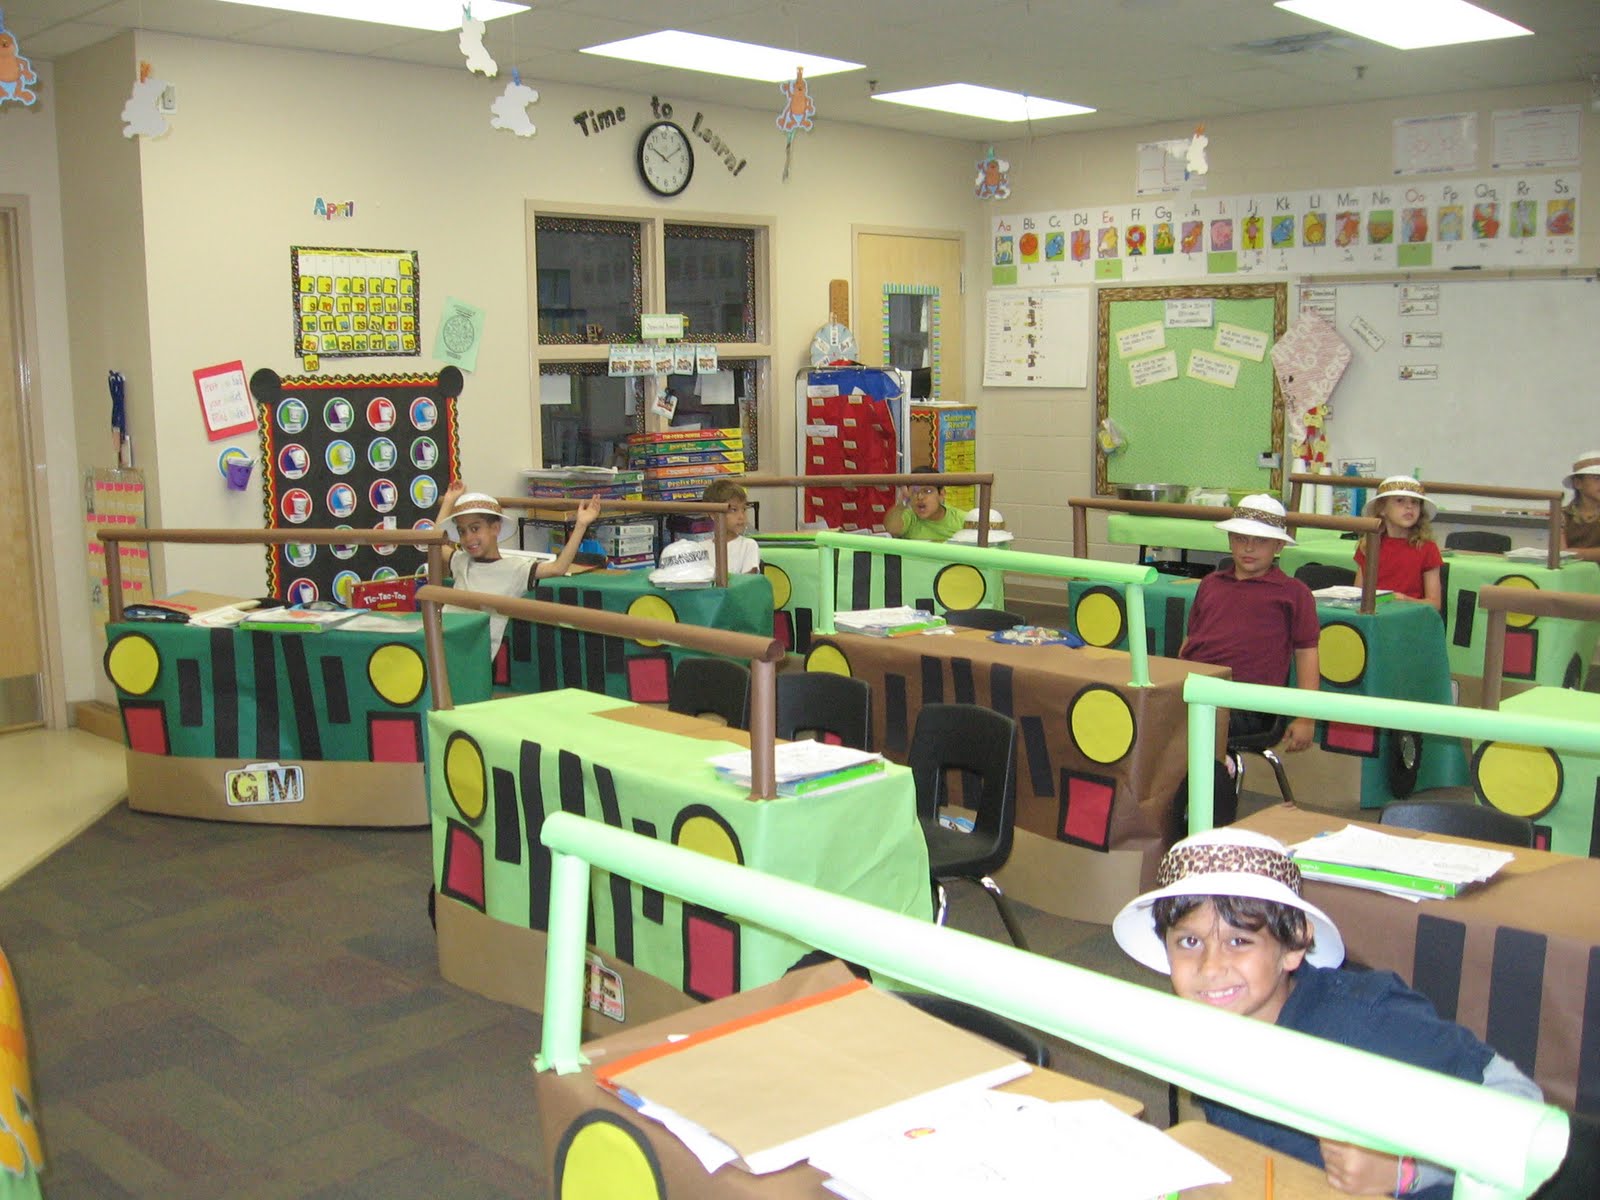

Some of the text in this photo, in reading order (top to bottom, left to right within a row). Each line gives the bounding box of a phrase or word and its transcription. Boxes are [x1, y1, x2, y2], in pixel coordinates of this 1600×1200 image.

[573, 95, 747, 176] Time to Learn!
[313, 197, 354, 220] April
[998, 220, 1011, 231] Aa
[1023, 218, 1035, 230] Bb
[1049, 216, 1061, 227] Cc
[1074, 213, 1088, 226] Dd
[1103, 211, 1114, 223] Ee
[1131, 208, 1141, 221] Ff
[1155, 206, 1172, 221] Gg
[1248, 200, 1258, 217] Jj
[1276, 197, 1290, 211] Kk
[1337, 192, 1358, 208] Mm
[1372, 191, 1391, 205] Nn
[1405, 189, 1424, 202] Oo
[1475, 184, 1497, 200] Qq
[1517, 181, 1531, 195] Rr
[1554, 179, 1569, 193] Ss
[308, 283, 313, 291] 2
[325, 283, 330, 292] 3
[359, 284, 364, 292] 5
[375, 284, 380, 292] 6
[391, 285, 396, 293] 7
[310, 303, 315, 311] 9
[322, 302, 331, 311] 10
[341, 303, 350, 311] 11
[356, 303, 364, 311] 12
[388, 303, 396, 311] 14
[404, 303, 412, 311] 15
[371, 321, 380, 330] 20
[387, 321, 396, 329] 21
[325, 340, 335, 348] 24
[342, 342, 351, 350] 25
[356, 341, 366, 349] 26
[372, 340, 381, 348] 27
[405, 340, 414, 348] 29
[306, 360, 317, 369] 30
[364, 591, 406, 604] Tic-Tac-Toe
